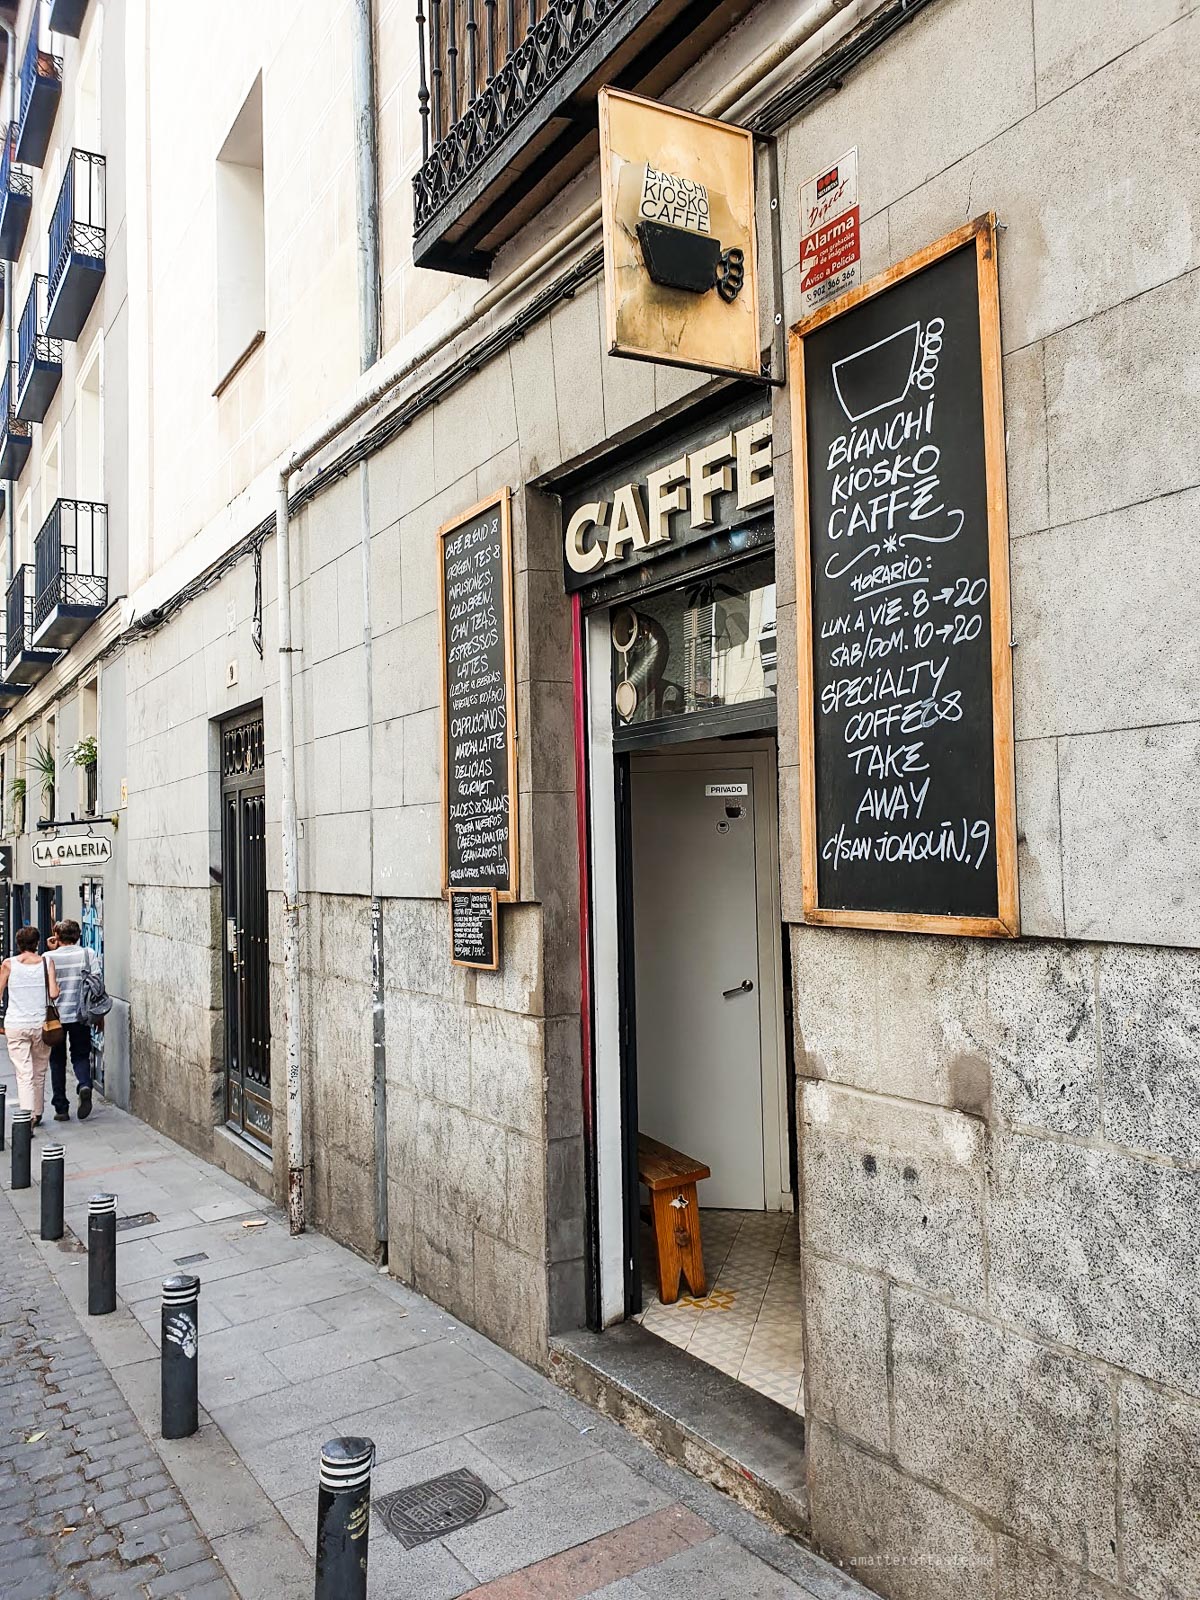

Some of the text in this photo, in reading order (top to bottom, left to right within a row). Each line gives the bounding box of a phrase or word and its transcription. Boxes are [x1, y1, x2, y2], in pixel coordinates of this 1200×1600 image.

[644, 181, 709, 215] KIOSKO
[641, 200, 709, 233] CAFFE
[804, 216, 855, 256] Alarma
[820, 247, 829, 257] con
[805, 270, 824, 288] Aviso
[832, 253, 855, 270] Policía
[820, 256, 827, 265] de
[812, 268, 856, 299] 902 366 366
[827, 393, 935, 471] BIANCHI
[831, 445, 941, 506] KIOSKO
[565, 415, 774, 573] CAFFE
[464, 524, 488, 549] BLEND
[850, 554, 932, 592] HORARIO:
[450, 600, 467, 620] COLD
[821, 614, 851, 638] LUN.
[854, 610, 865, 632] A
[870, 597, 910, 626] VIE.
[449, 628, 499, 663] ESPRESSOS
[451, 616, 469, 642] CHAI
[457, 653, 489, 679] LATTES
[821, 656, 950, 714] SPECIALTY
[451, 704, 506, 738] CAPPUCCINOS
[454, 731, 505, 761] MATCHA LATTE
[848, 741, 930, 780] TAKE
[454, 757, 493, 779] DELICIAS
[449, 800, 474, 820] DULCES
[855, 777, 930, 824] AWAY
[36, 842, 108, 860] LA GALERIA
